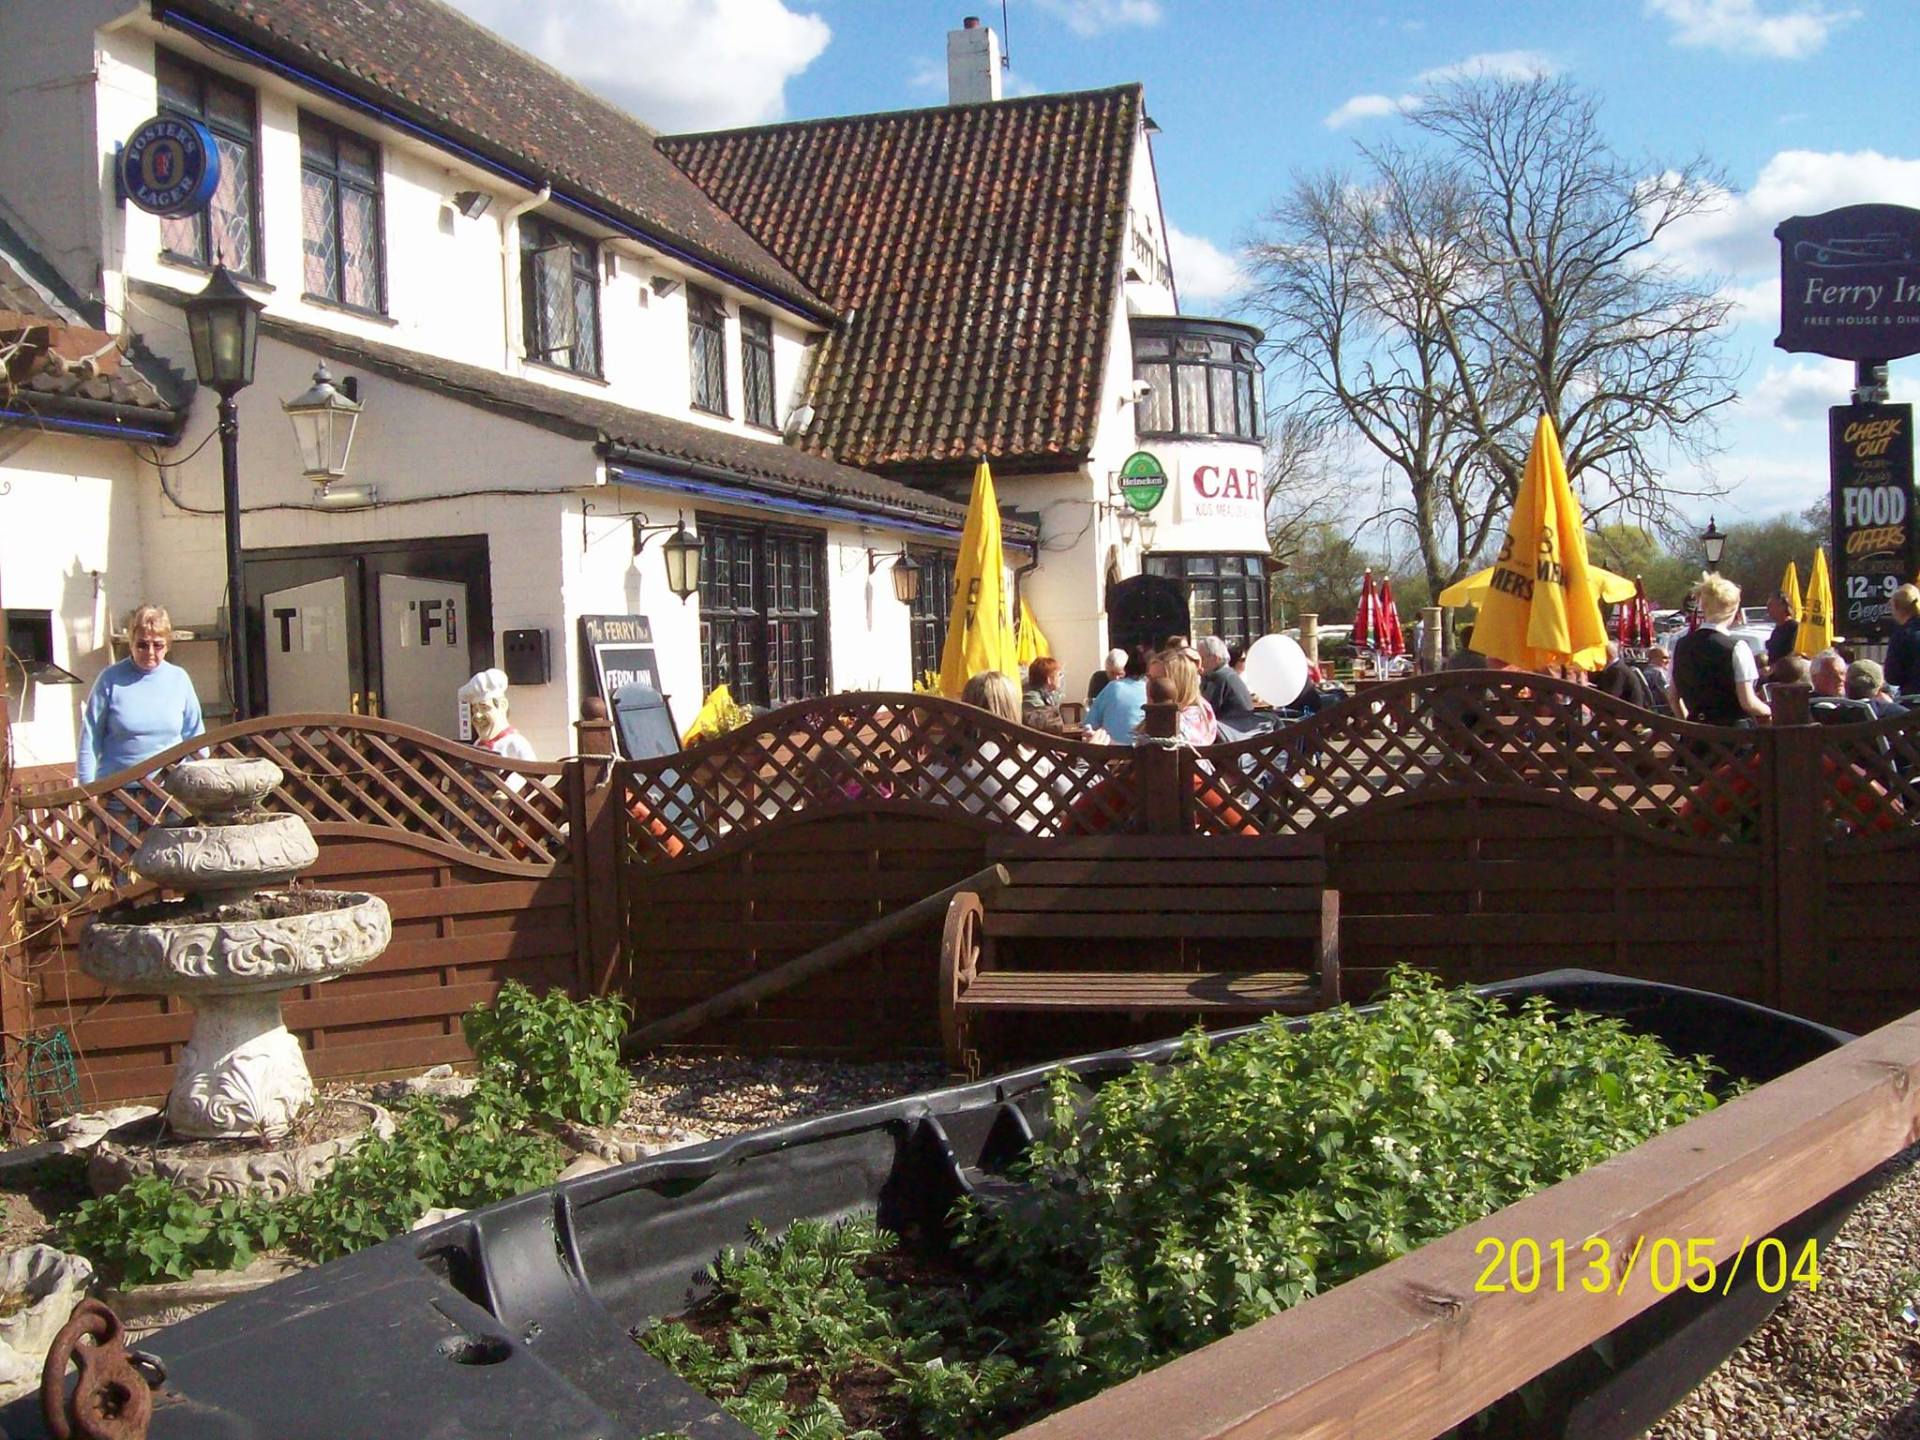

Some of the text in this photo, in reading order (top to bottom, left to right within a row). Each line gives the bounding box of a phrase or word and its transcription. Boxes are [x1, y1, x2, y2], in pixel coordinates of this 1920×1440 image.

[137, 176, 194, 206] LAGER
[1803, 277, 1884, 311] Ferry
[1803, 315, 1831, 326] FREE
[1836, 315, 1879, 326] HOUSE
[1844, 418, 1903, 443] CHECK
[1855, 436, 1893, 458] OUT
[1122, 476, 1163, 487] Heineken
[1842, 485, 1906, 527] FOOD
[1846, 526, 1906, 555] OFFERS
[587, 620, 603, 641] The
[604, 621, 636, 641] FERRY
